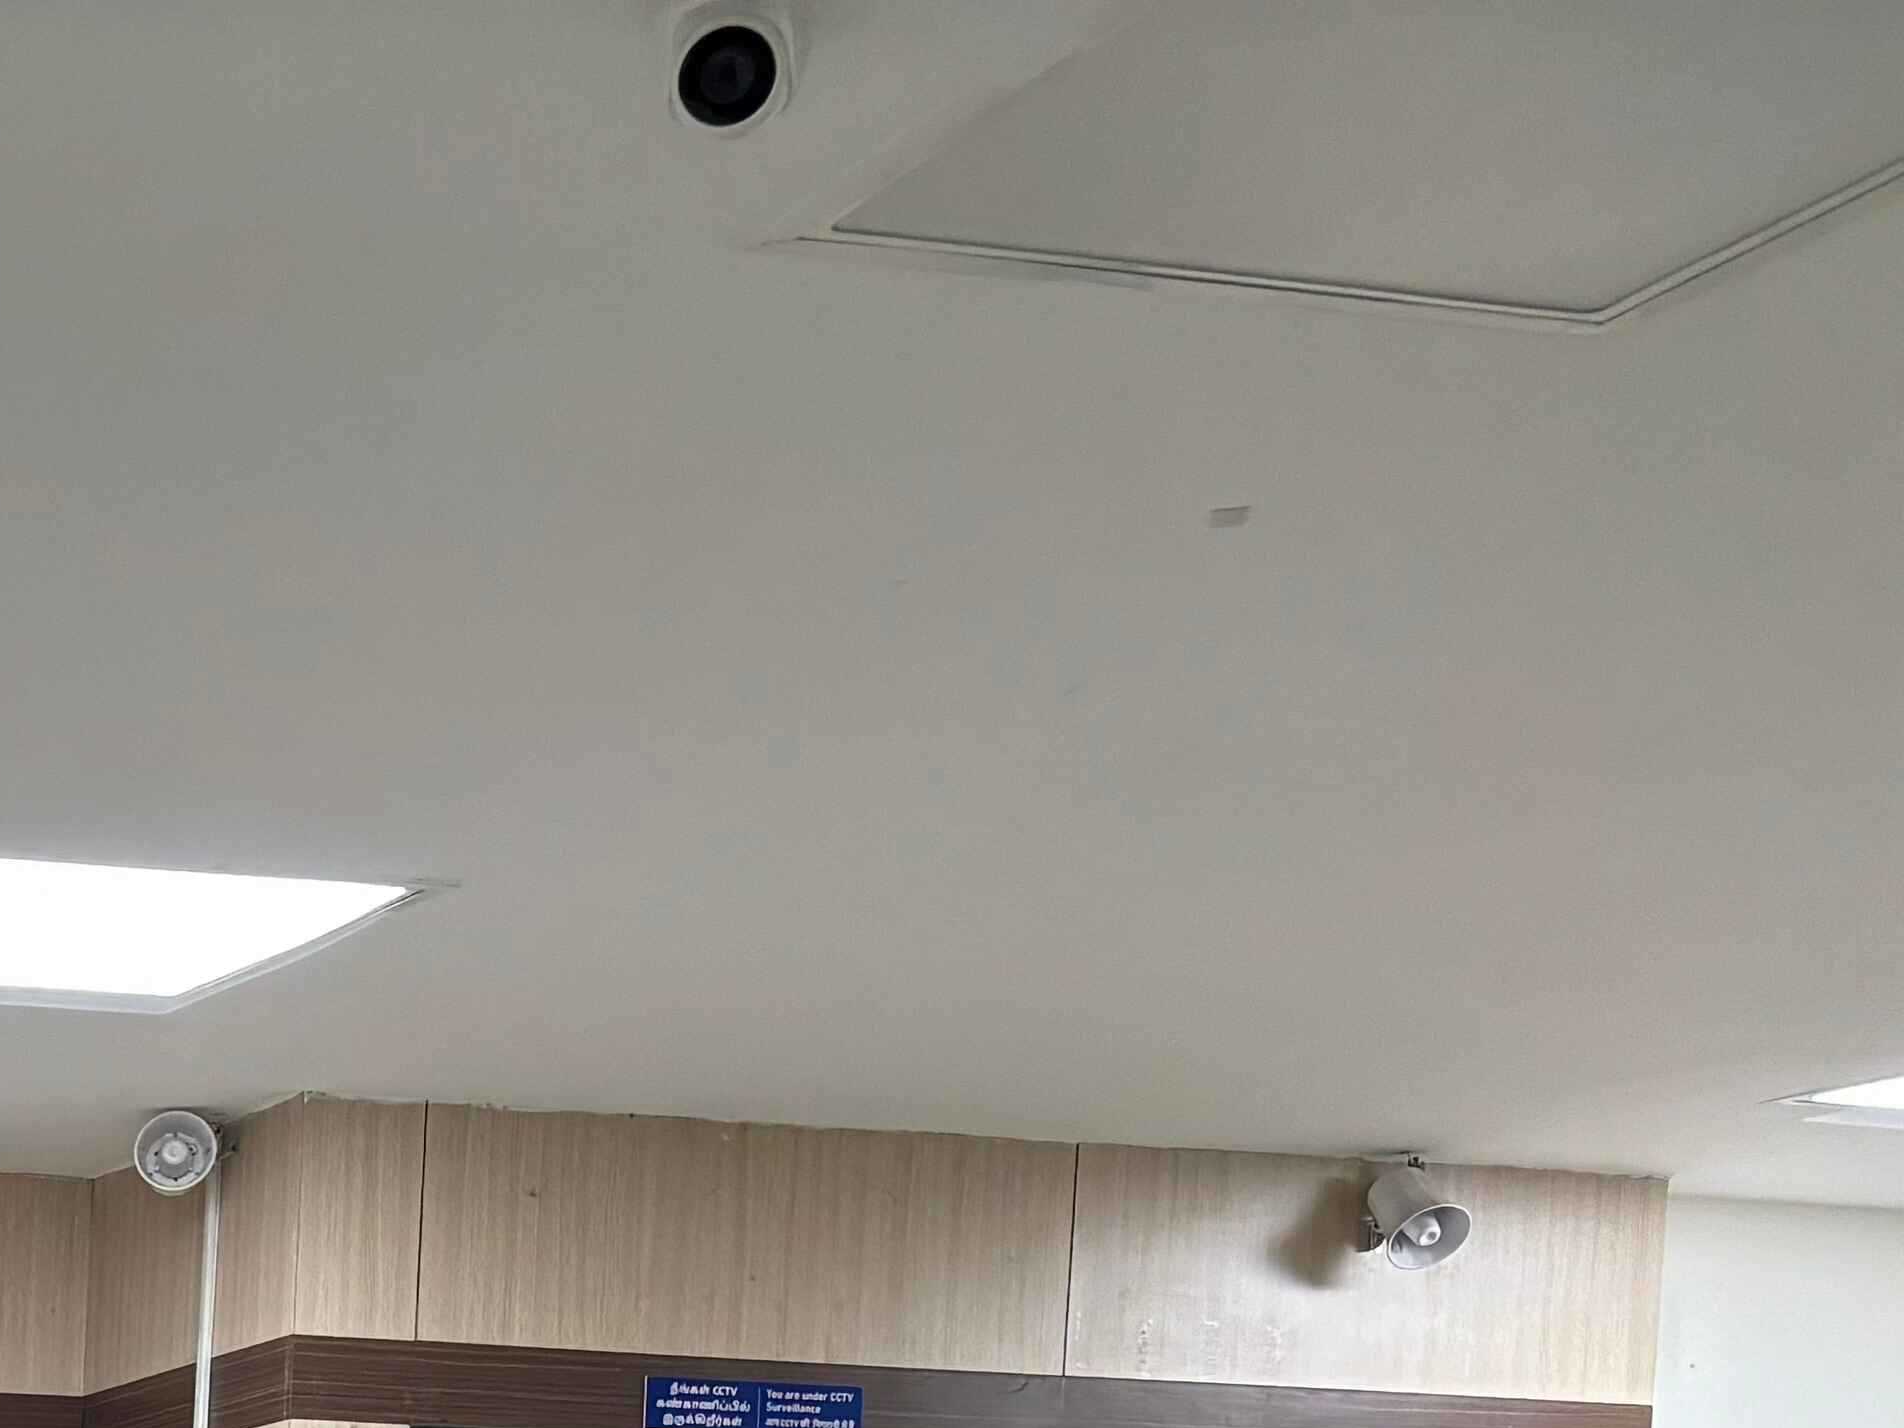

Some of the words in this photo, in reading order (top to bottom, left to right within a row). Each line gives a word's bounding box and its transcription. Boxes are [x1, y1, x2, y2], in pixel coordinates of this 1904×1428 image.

[713, 1385, 738, 1396] CCTV
[766, 1389, 783, 1400] You
[784, 1391, 800, 1400] are
[801, 1391, 828, 1402] under
[830, 1392, 855, 1403] CCTV
[766, 1403, 821, 1415] Surveillance
